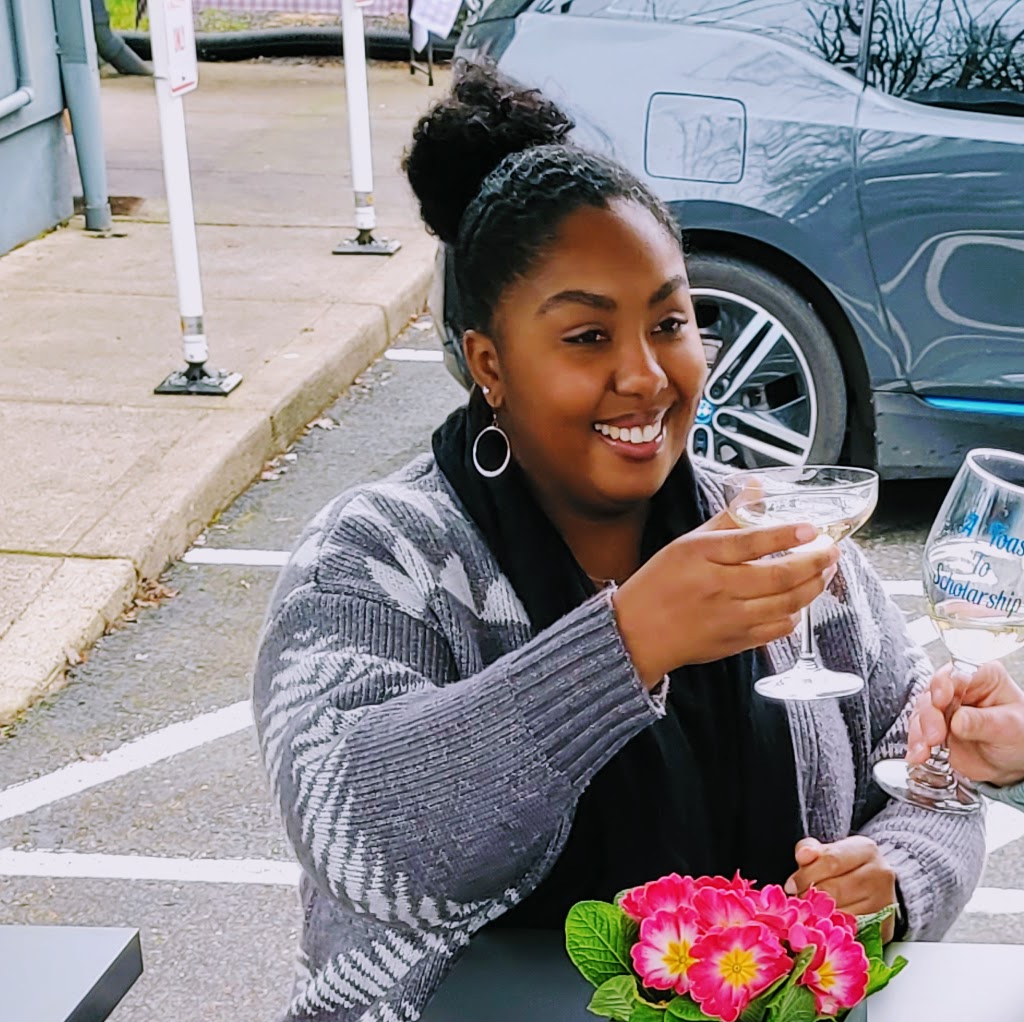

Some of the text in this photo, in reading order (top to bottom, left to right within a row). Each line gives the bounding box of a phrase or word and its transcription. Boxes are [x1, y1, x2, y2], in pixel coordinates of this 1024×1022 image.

[961, 510, 980, 537] A
[971, 549, 992, 578] To
[932, 562, 1023, 619] Scholarship
